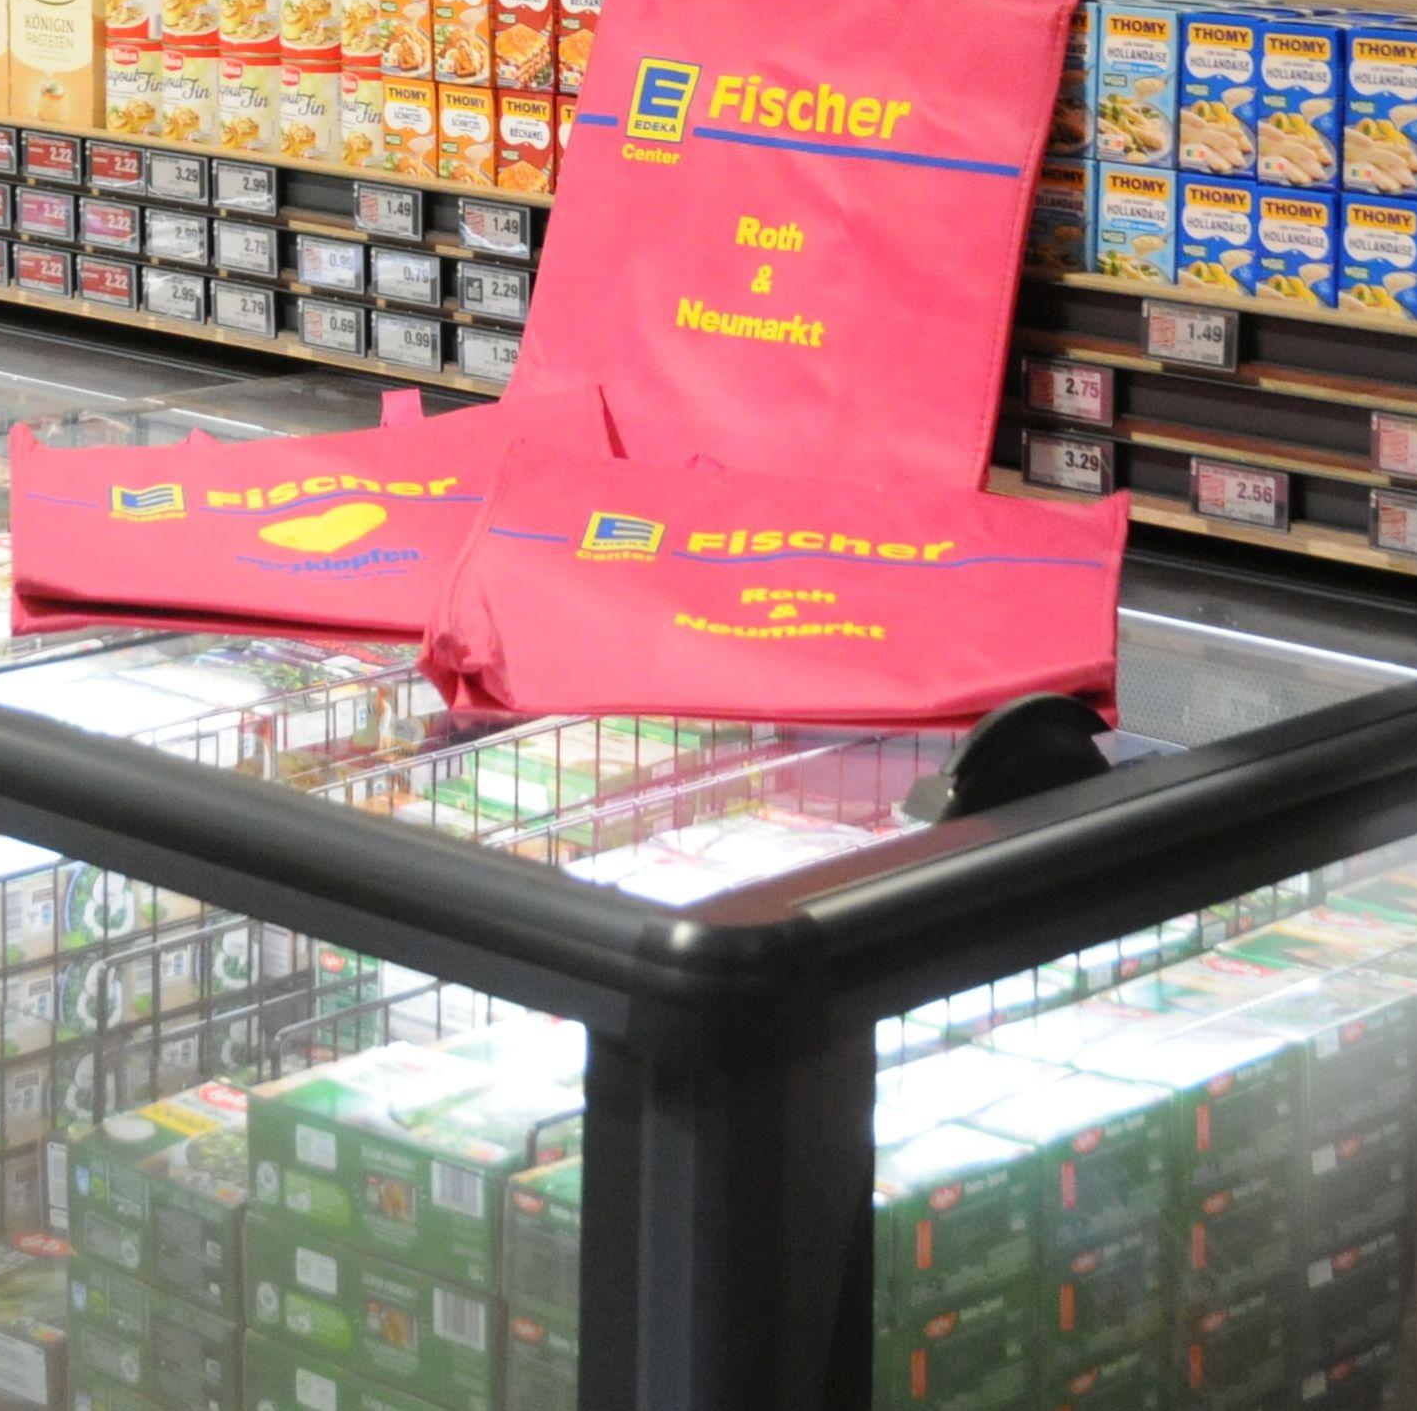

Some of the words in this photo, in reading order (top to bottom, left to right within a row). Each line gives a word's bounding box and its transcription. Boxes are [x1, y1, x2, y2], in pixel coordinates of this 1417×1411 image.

[24, 13, 75, 33] KÖNIGIN
[1110, 17, 1167, 35] THOMY
[1192, 27, 1249, 44] THOMY
[1268, 37, 1326, 54] THOMY
[1358, 41, 1417, 60] THOMY
[1107, 48, 1168, 64] HOLLANDAISE
[1190, 55, 1251, 73] HOLLANDAISE
[1265, 67, 1329, 84] HOLLANDAISE
[388, 86, 428, 102] THOMY
[444, 93, 486, 109] THOMY
[505, 99, 548, 115] THOMY
[707, 74, 912, 140] Fischer
[633, 119, 678, 135] EDEKA
[621, 142, 681, 166] Center
[113, 157, 138, 173] 2.22
[175, 167, 198, 184] 3.29
[243, 175, 266, 192] 2.99
[1109, 174, 1166, 192] THOMY
[1189, 188, 1247, 205] THOMY
[386, 200, 412, 218] 1.49
[1106, 202, 1167, 221] HOLLANDAISE
[1264, 202, 1323, 219] THOMY
[1352, 208, 1412, 227] THOMY
[493, 217, 519, 235] 1.49
[735, 215, 804, 252] Roth
[1186, 217, 1249, 234] HOLLANDAISE
[1262, 231, 1326, 249] HOLLANDAISE
[1348, 239, 1414, 259] HOLLANDAISE
[750, 264, 773, 294] &
[171, 285, 195, 302] 2.99
[491, 280, 518, 299] 2.29
[240, 298, 264, 315] 2.79
[329, 316, 355, 334] 0.69
[675, 297, 825, 348] Neumarkt
[404, 330, 430, 348] 0.99
[1187, 322, 1223, 344] 1.49
[1065, 377, 1099, 399] 2.75
[1064, 450, 1099, 472] 3.29
[206, 474, 458, 510] Fischer
[1236, 481, 1273, 504] 2.56
[686, 529, 955, 562] Fischer
[740, 587, 836, 605] Roth
[674, 611, 886, 640] Neumarkt
